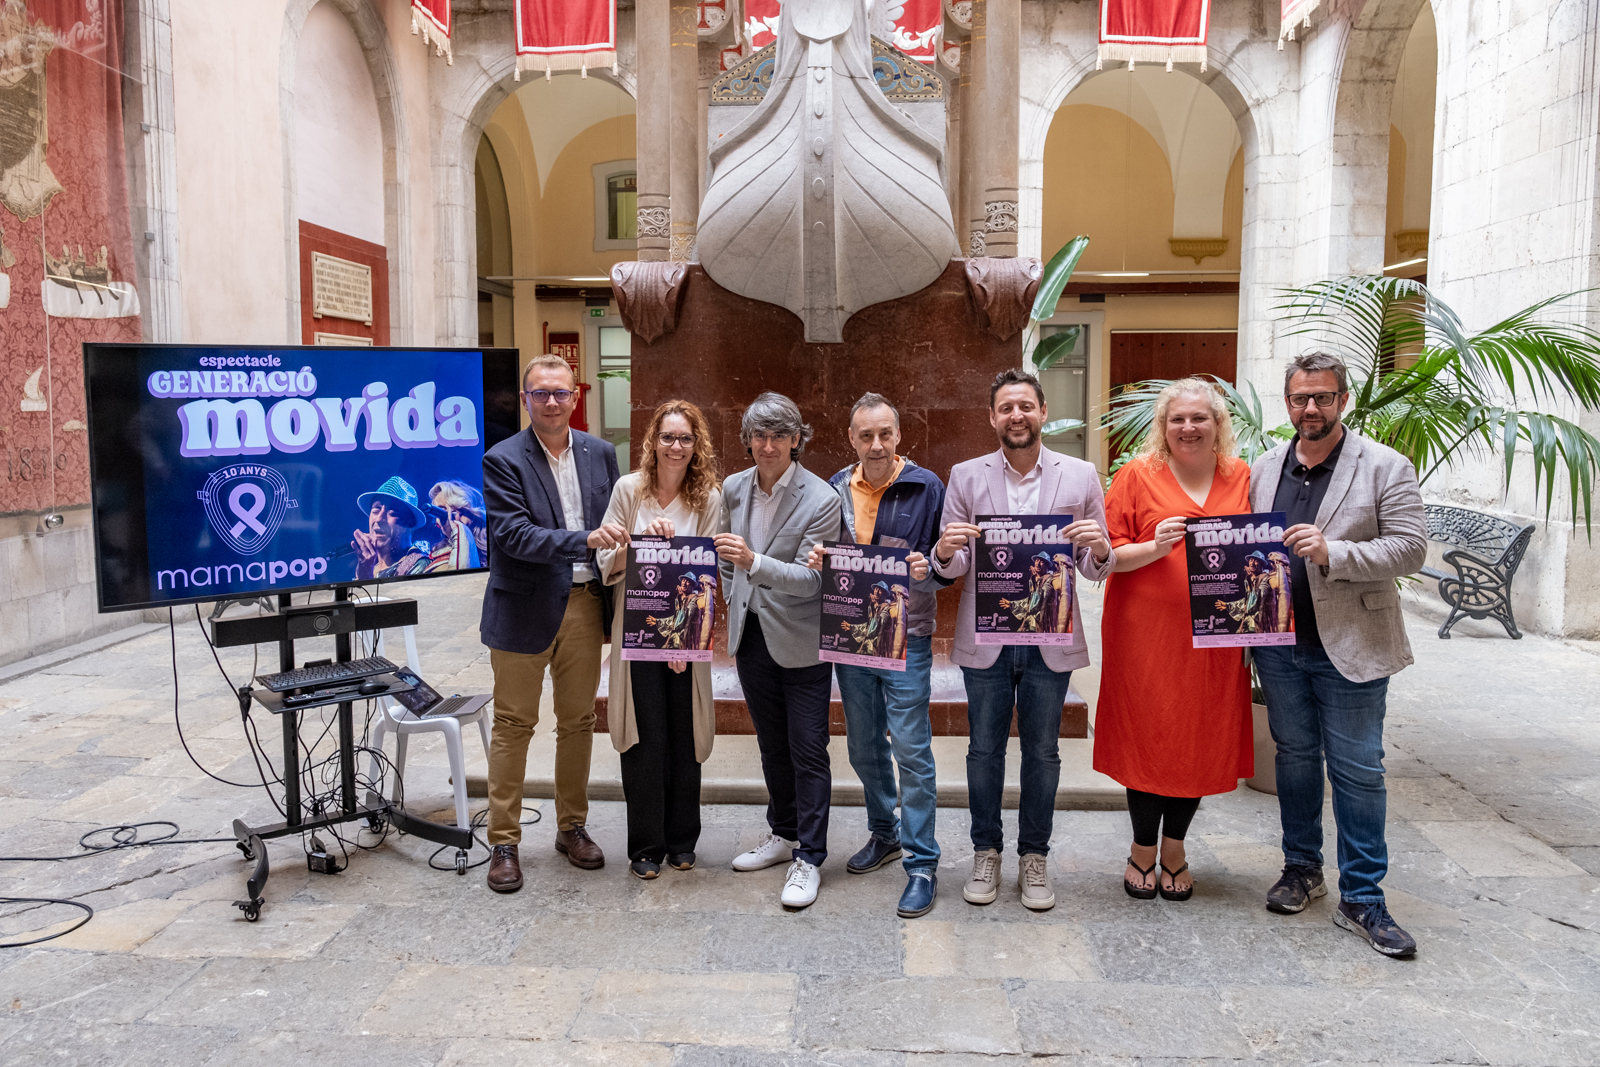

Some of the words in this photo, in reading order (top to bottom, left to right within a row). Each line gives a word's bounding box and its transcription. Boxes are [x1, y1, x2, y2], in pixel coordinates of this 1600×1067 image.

[199, 354, 282, 370] espectacle
[147, 365, 318, 399] GENERACIÓ
[176, 380, 480, 458] movida
[222, 467, 238, 480] 10
[239, 466, 268, 477] ANYS
[1194, 522, 1284, 547] movida
[635, 545, 716, 566] movida
[157, 556, 328, 591] mamapop
[830, 554, 908, 576] movida
[977, 572, 1023, 580] mamapop
[1190, 573, 1238, 581] mamapop
[626, 589, 670, 598] mamapop
[823, 594, 863, 605] mamapop
